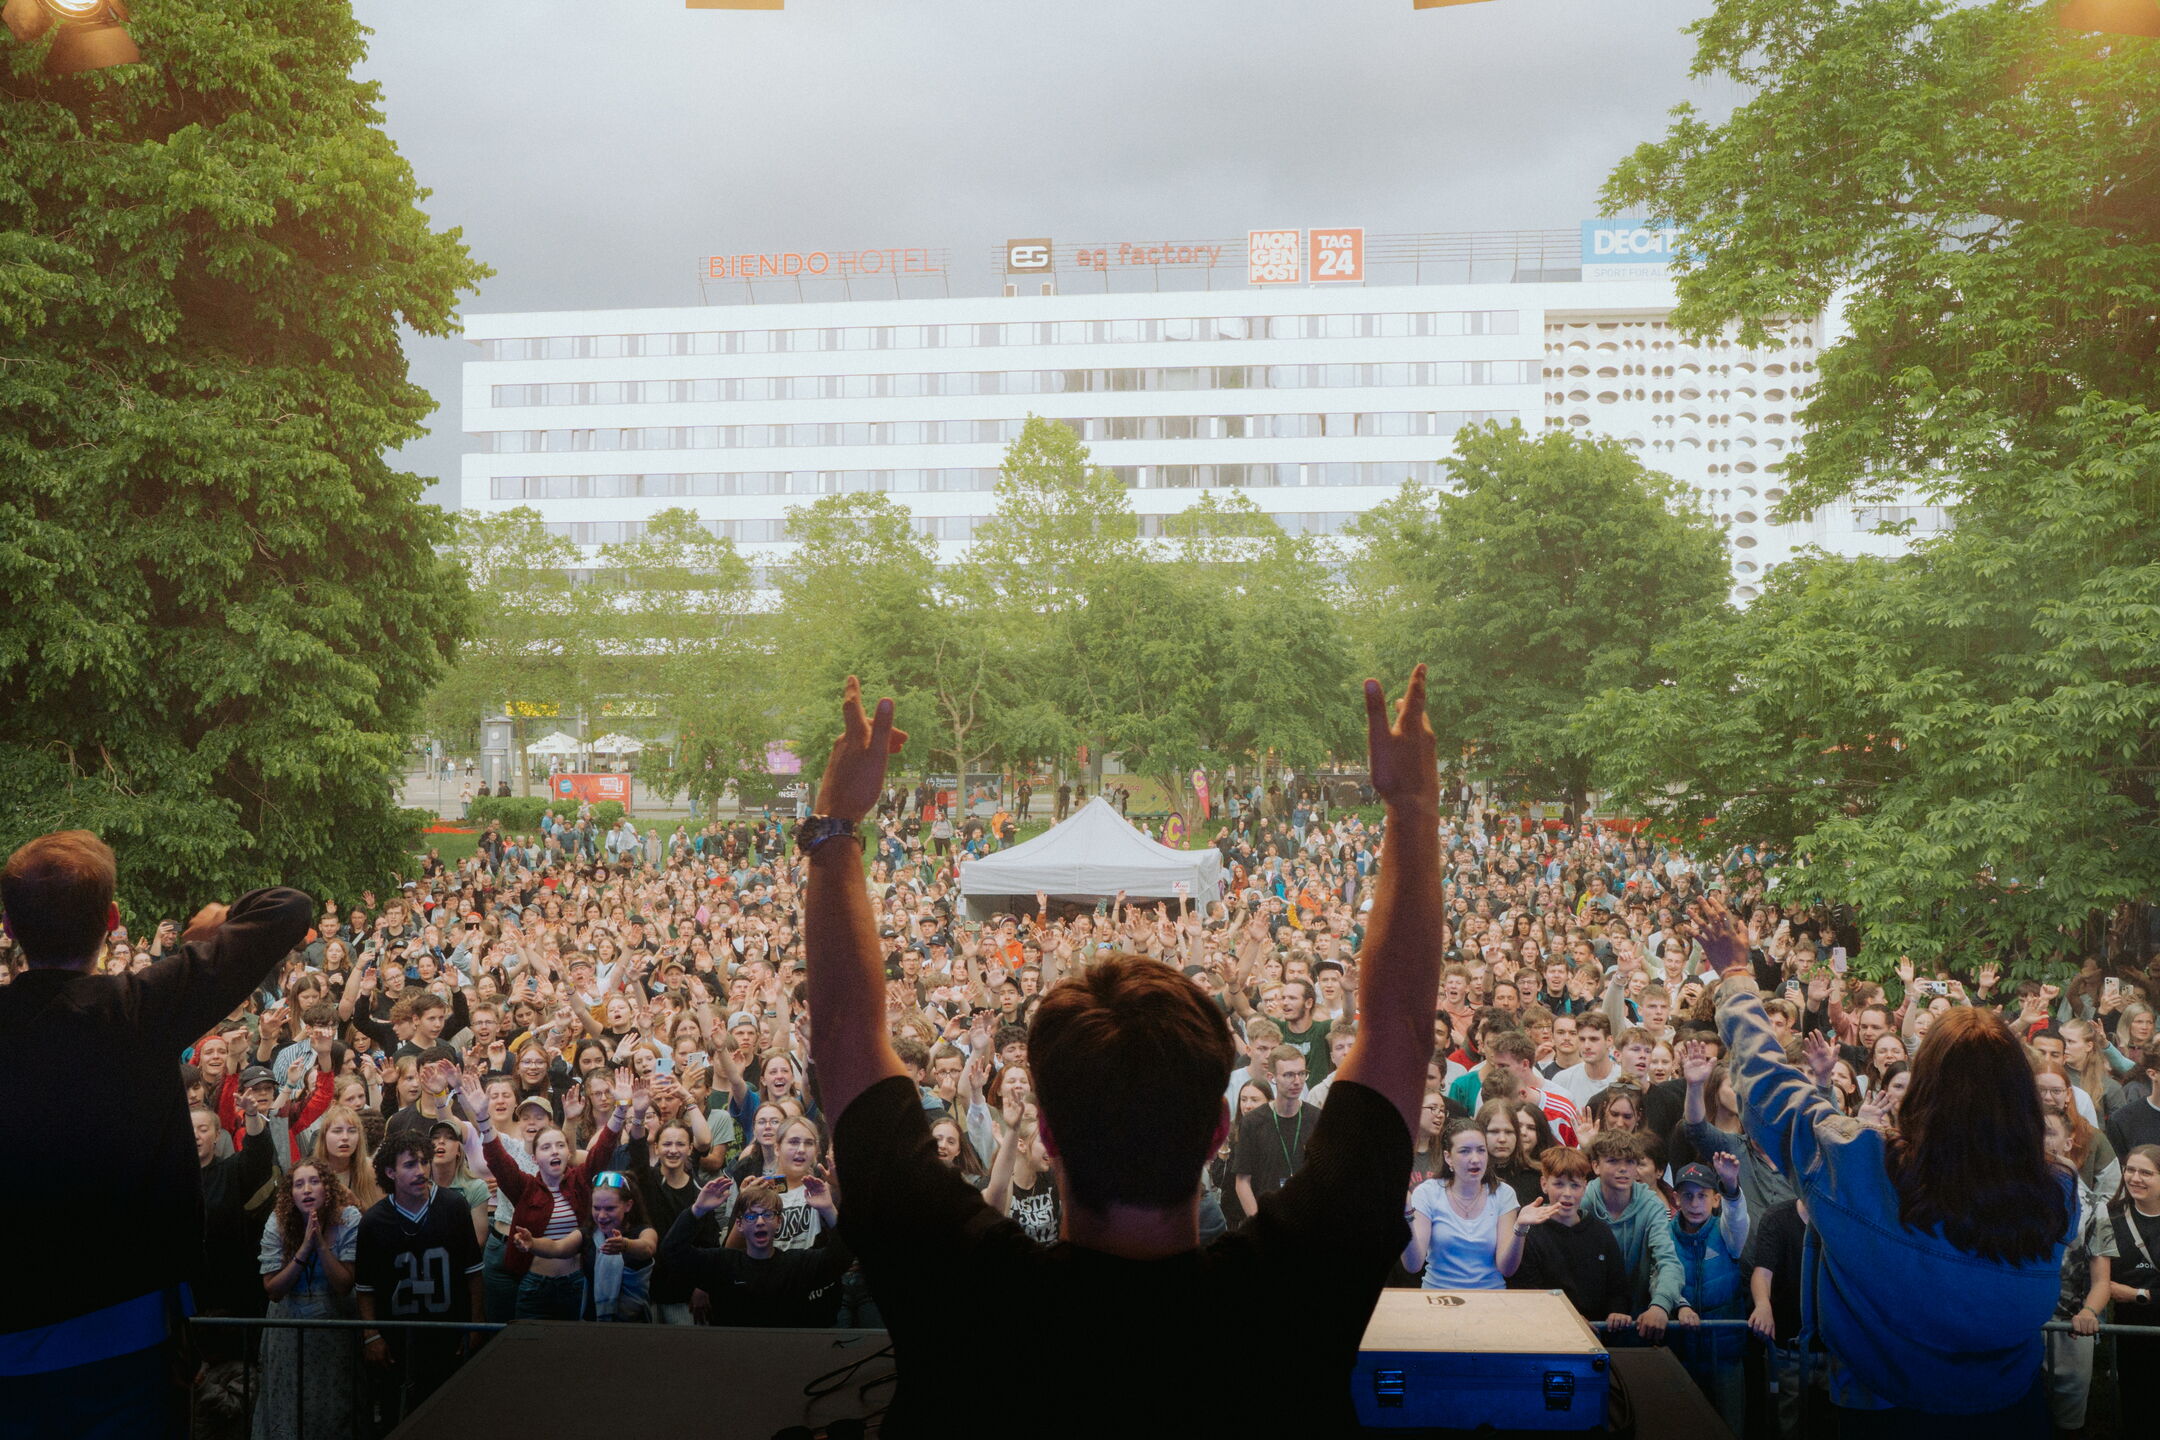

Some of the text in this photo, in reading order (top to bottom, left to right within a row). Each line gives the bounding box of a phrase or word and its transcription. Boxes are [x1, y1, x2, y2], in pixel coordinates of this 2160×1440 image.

[1251, 232, 1297, 249] MOR
[1318, 235, 1353, 249] TAG
[709, 248, 939, 278] BIENDO HOTEL
[1118, 241, 1222, 268] factory
[1251, 248, 1297, 265] GEN
[1318, 250, 1355, 275] 24
[1251, 264, 1297, 280] POST
[1594, 267, 1626, 278] SPORT
[1629, 267, 1649, 277] FOR
[391, 1246, 451, 1316] 20
